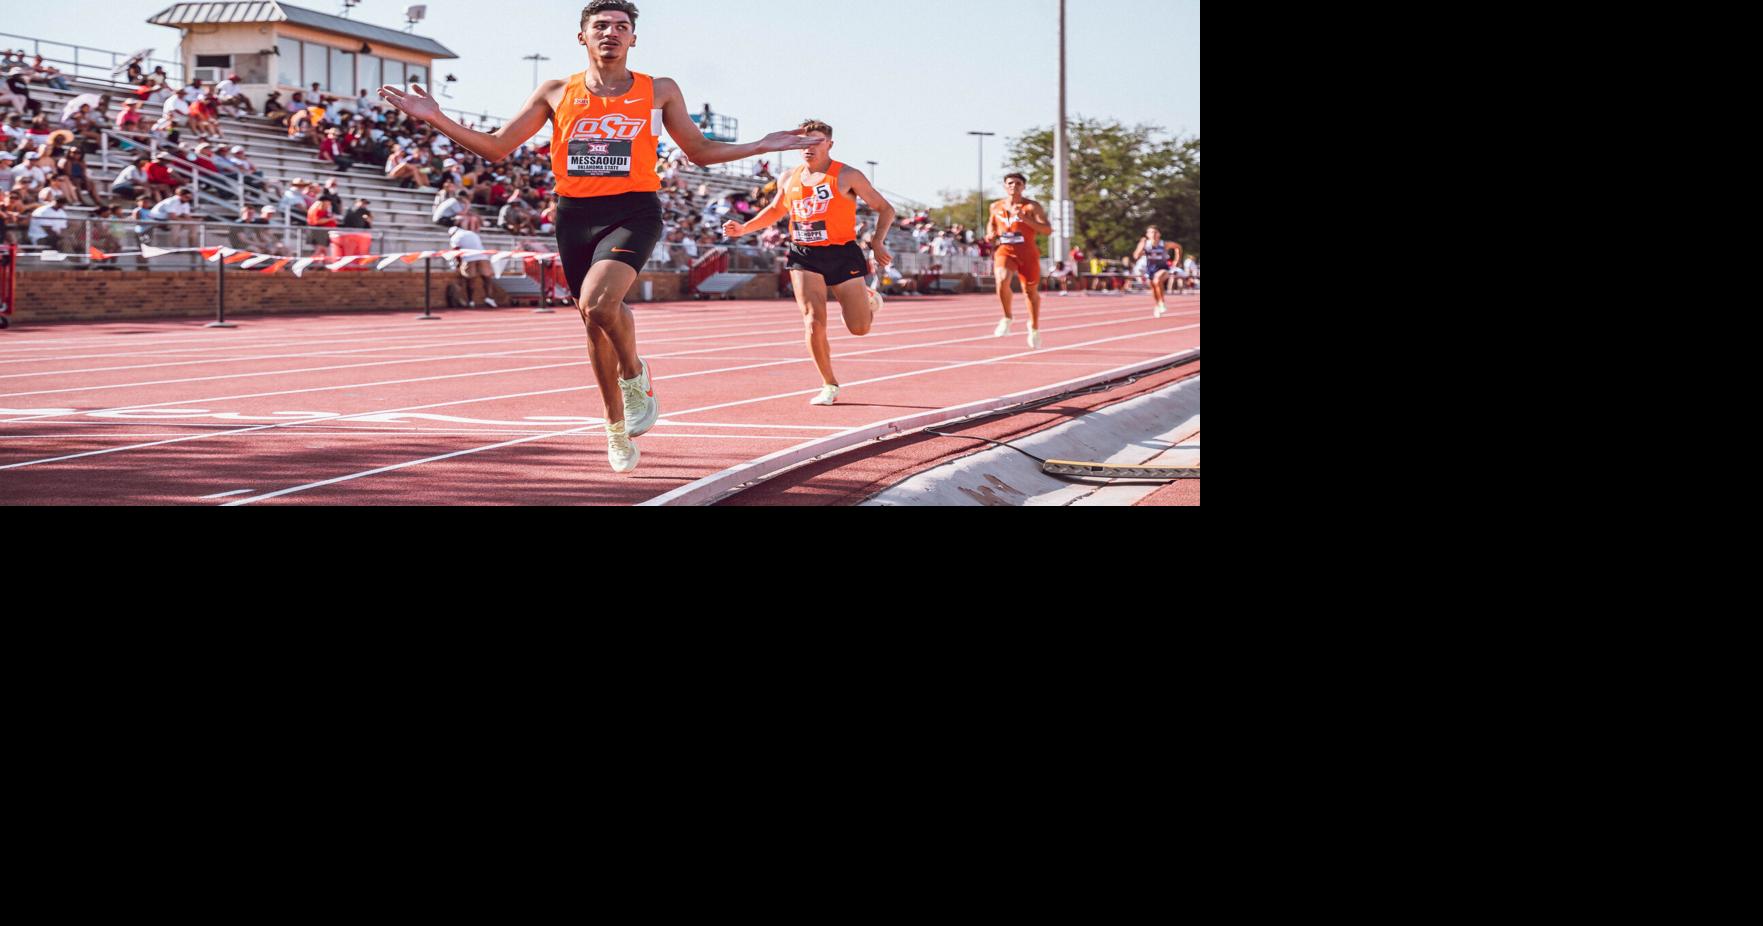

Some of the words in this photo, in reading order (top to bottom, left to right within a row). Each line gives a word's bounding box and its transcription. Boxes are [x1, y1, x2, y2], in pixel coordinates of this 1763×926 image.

[570, 113, 647, 140] OSU
[571, 156, 627, 165] MESSAOUDI
[816, 185, 829, 199] 5
